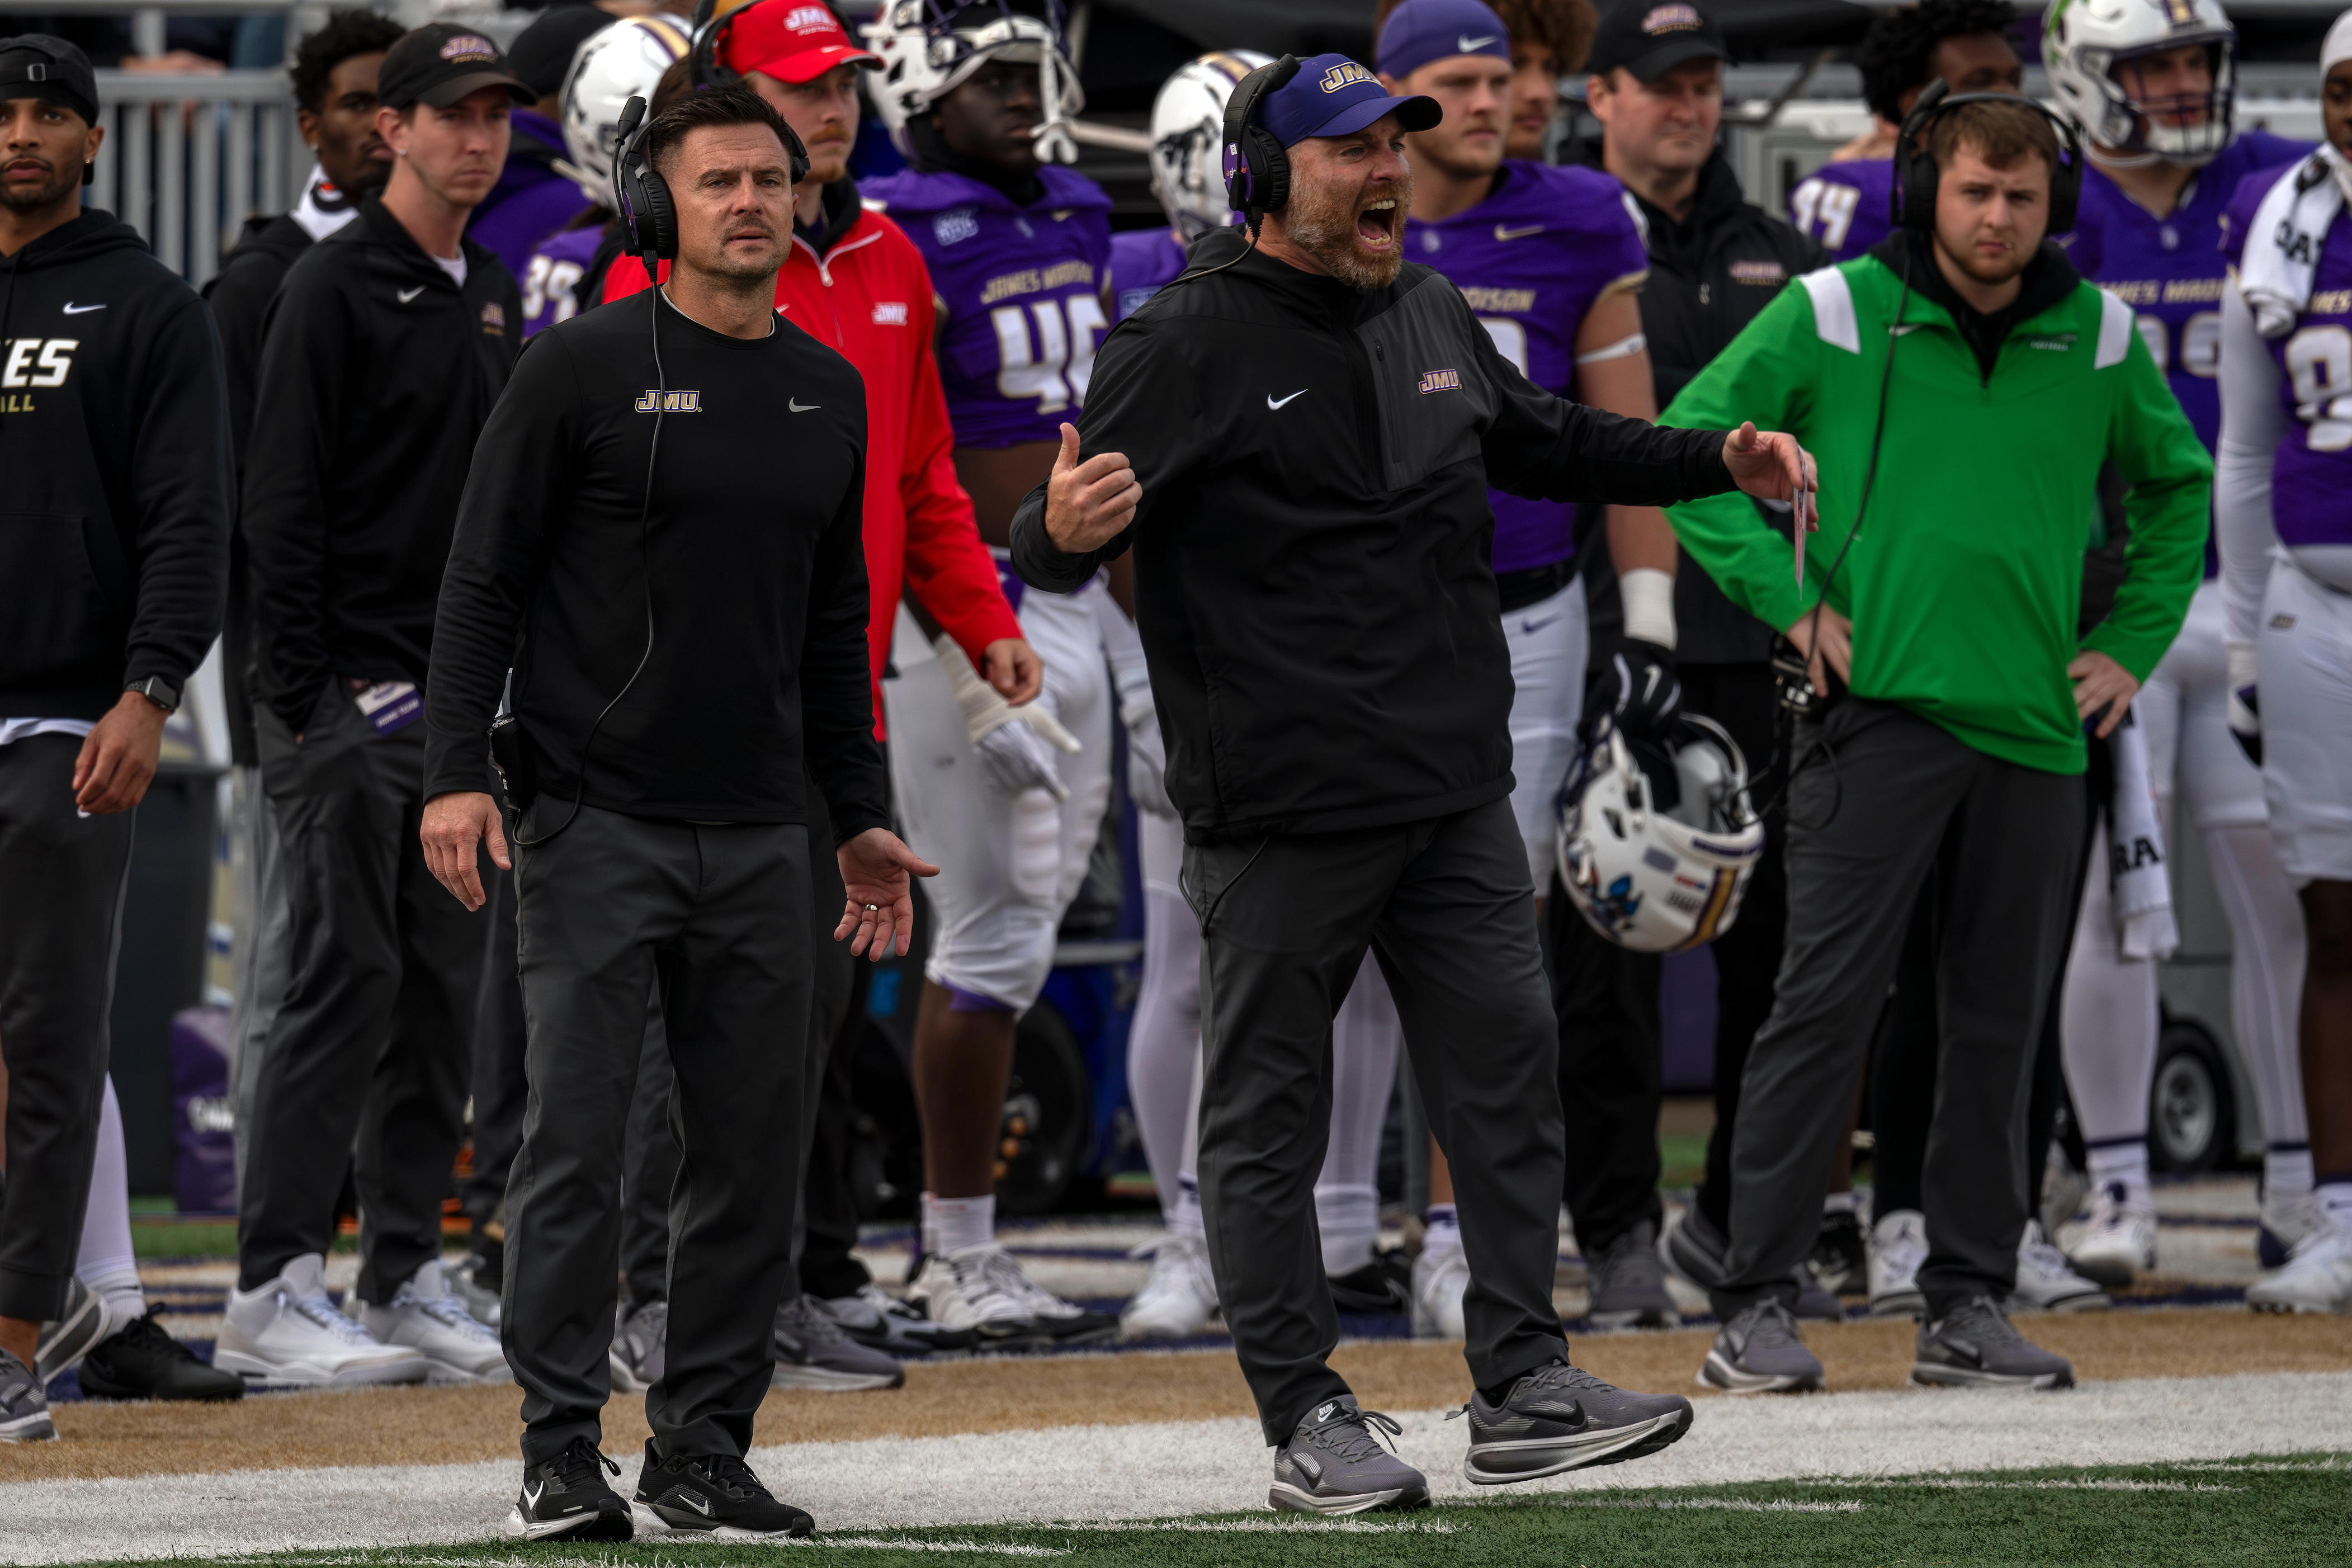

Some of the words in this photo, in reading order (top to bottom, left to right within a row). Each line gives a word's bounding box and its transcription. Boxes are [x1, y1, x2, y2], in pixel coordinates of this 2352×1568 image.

[872, 303, 907, 324] JMU
[2, 338, 80, 388] ES
[1420, 370, 1459, 393] JMU
[636, 391, 698, 411] JMU
[1319, 1403, 1333, 1416] RUN
